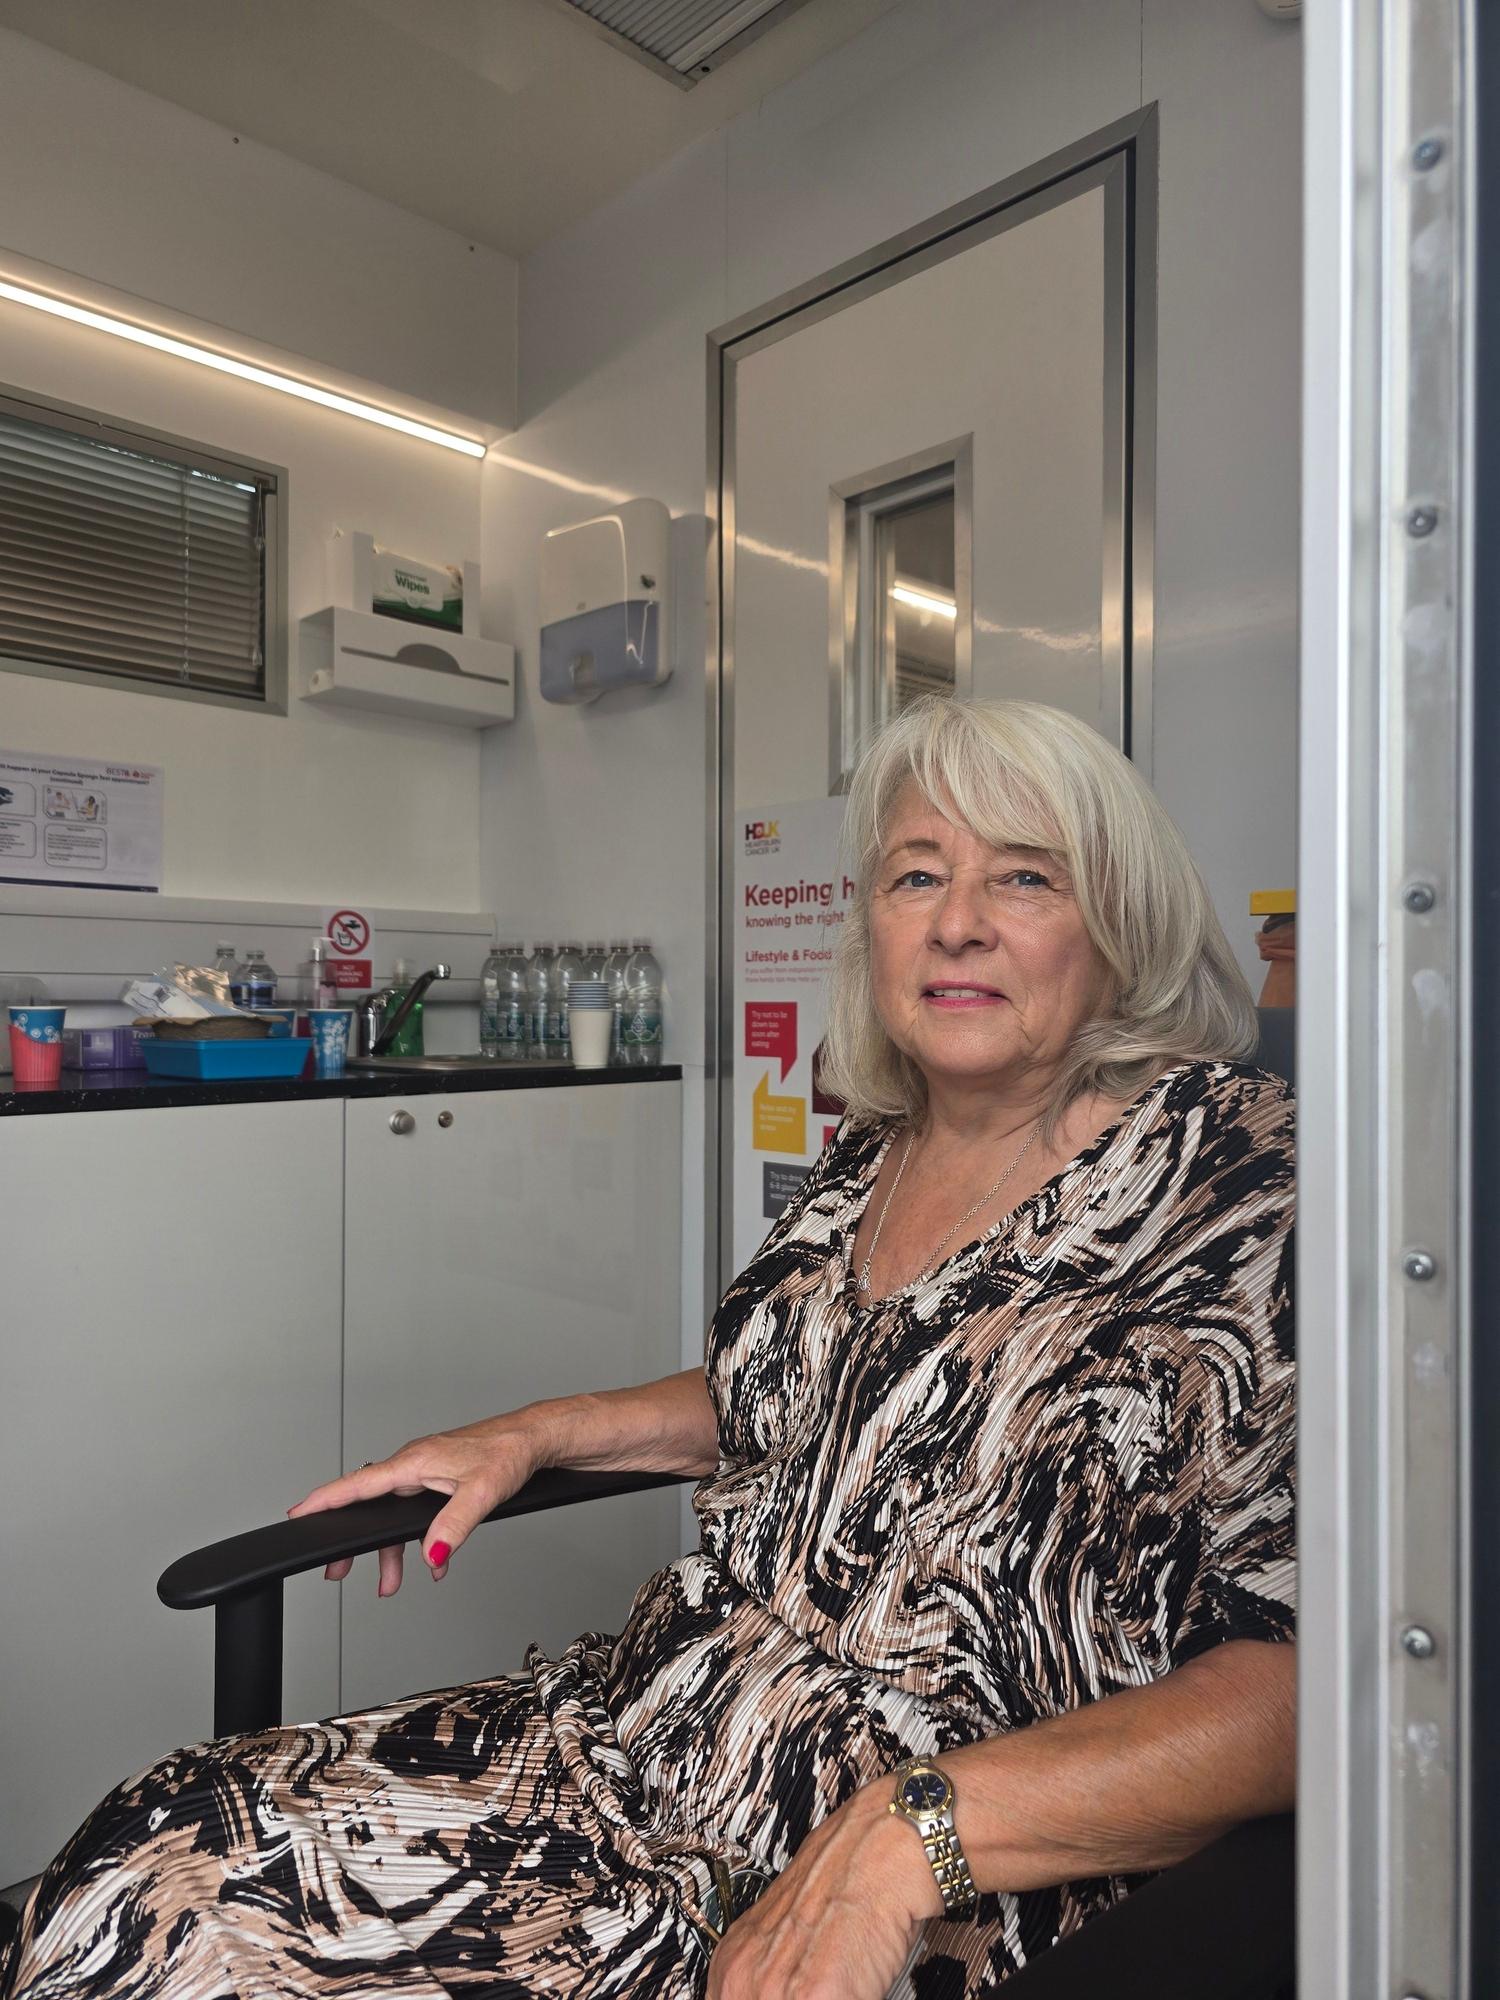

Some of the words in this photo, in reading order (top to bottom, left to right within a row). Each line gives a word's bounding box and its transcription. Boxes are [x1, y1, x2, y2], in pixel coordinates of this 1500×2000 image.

[394, 574, 431, 595] Wipes
[745, 879, 833, 909] Keeping
[745, 914, 792, 928] knowing
[795, 912, 814, 926] the
[816, 911, 845, 926] right
[745, 950, 790, 964] Lifestyle
[792, 949, 800, 961] &
[803, 948, 833, 961] Food
